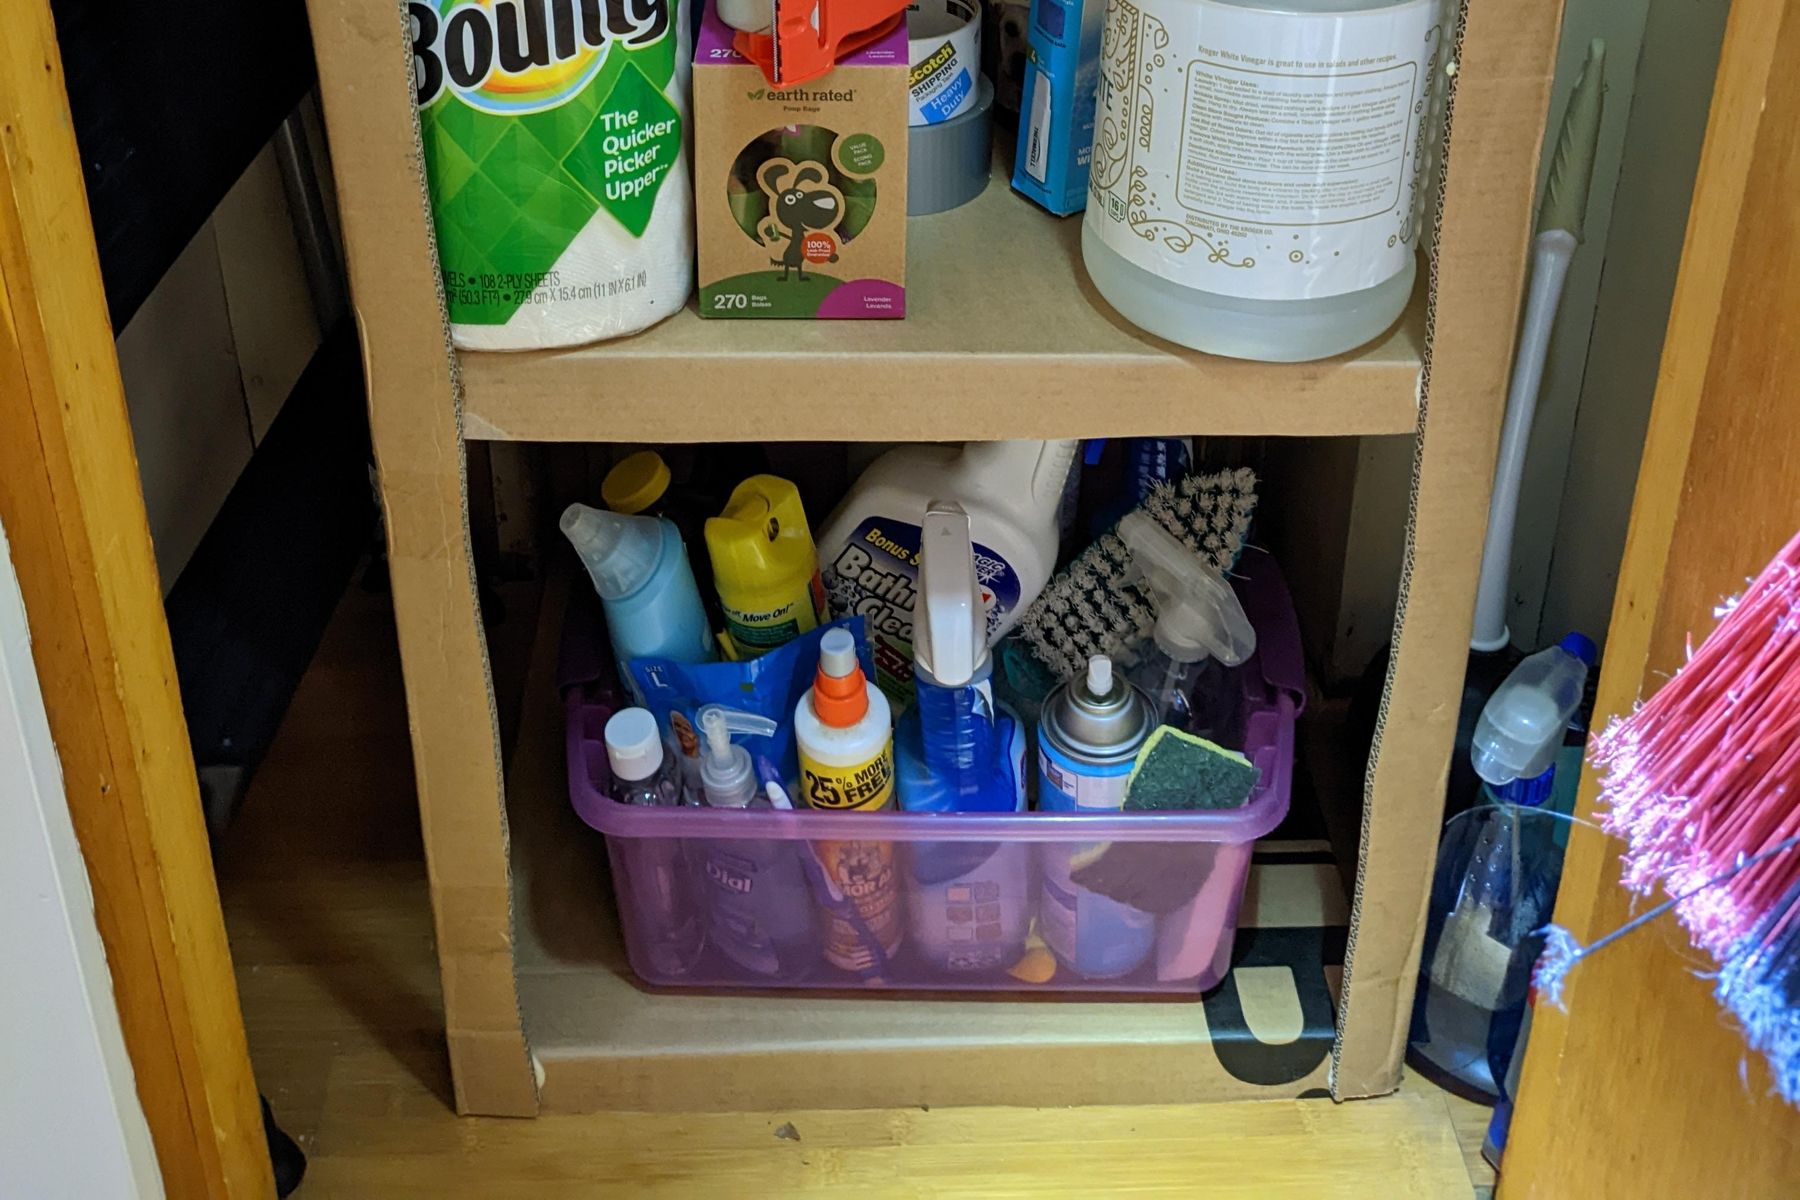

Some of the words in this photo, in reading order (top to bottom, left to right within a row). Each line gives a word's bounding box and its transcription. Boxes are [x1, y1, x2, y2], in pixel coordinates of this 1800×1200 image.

[1220, 49, 1240, 61] White
[1241, 53, 1266, 65] Vinegar
[911, 57, 959, 99] SHIPPING
[766, 88, 809, 102] earth
[812, 89, 854, 102] rated
[930, 77, 964, 110] Heavy
[941, 90, 965, 117] Duty
[600, 110, 638, 132] The
[602, 119, 676, 156] Quicker
[604, 144, 661, 179] Picker
[807, 240, 831, 249] 100%
[480, 274, 495, 288] 108
[524, 270, 561, 288] SHEETS
[558, 286, 577, 302] 15.4
[714, 293, 748, 309] 270
[864, 528, 910, 561] Bonus
[742, 613, 771, 623] Move
[650, 671, 668, 688] L
